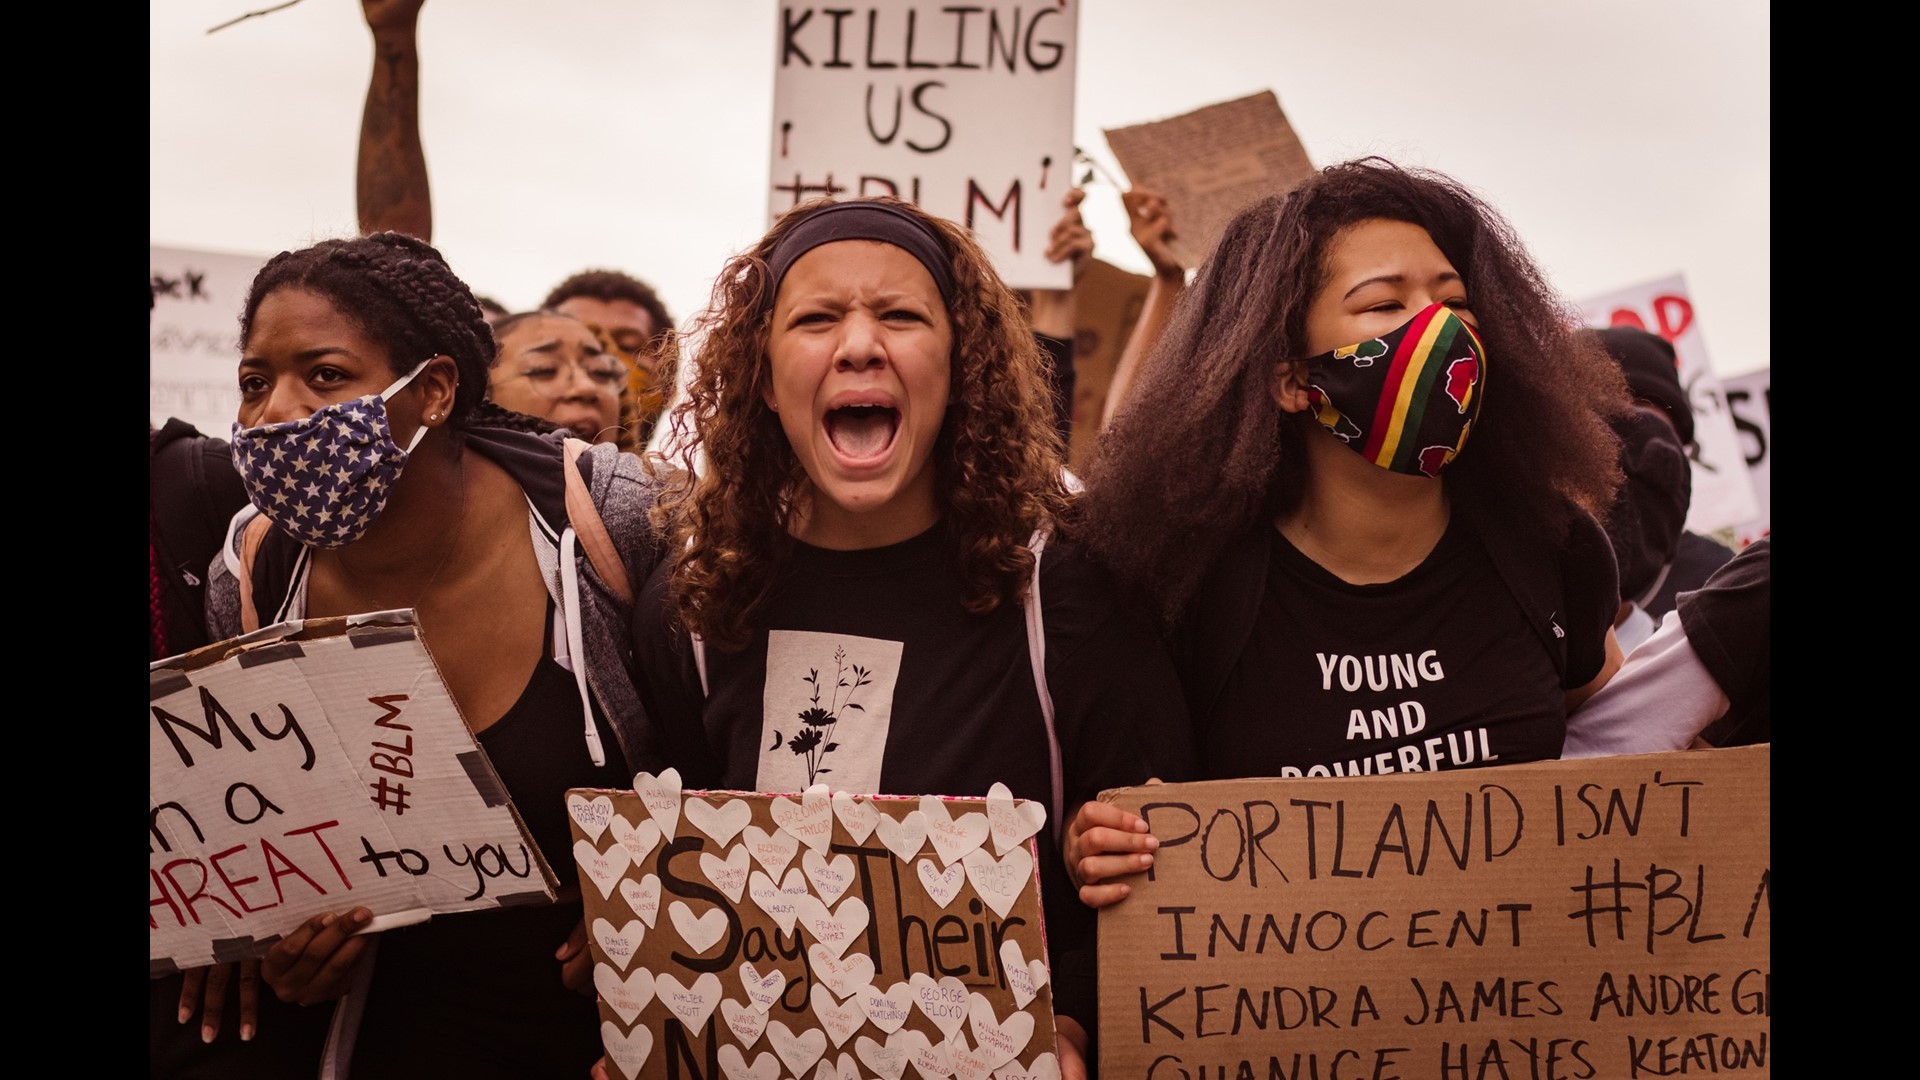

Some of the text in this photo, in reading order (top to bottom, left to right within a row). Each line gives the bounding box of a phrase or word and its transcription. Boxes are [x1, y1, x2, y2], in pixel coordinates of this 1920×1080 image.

[782, 7, 1065, 73] KILLING
[866, 81, 952, 153] US
[1316, 650, 1445, 691] YOUNG
[151, 685, 316, 771] My
[1346, 701, 1427, 740] AND
[368, 694, 414, 815] #BLM
[225, 782, 285, 825] a
[572, 803, 611, 815] TRAYVON
[777, 797, 830, 829] BREONNA
[576, 813, 609, 827] MARTIN
[795, 819, 832, 837] TAYLOR
[933, 819, 967, 838] GEORGE
[1140, 771, 1704, 888] PORTLAND ISN'T
[360, 836, 429, 878] to
[443, 843, 532, 902] you
[970, 864, 1017, 881] TAMIR
[979, 876, 1012, 897] RICE
[657, 836, 1026, 1013] Say Their
[814, 919, 846, 931] FRANK
[1157, 903, 1532, 960] INNOCENT
[604, 936, 629, 947] DANTE
[672, 992, 706, 1005] WALTER
[676, 1005, 701, 1017] SCOTT
[920, 986, 966, 1004] GEORGE
[925, 1001, 963, 1020] FLOYD
[1139, 983, 1380, 1044] KENDRA
[1404, 977, 1563, 1025] JAMES
[1590, 971, 1722, 1022] ANDRE
[978, 1031, 1016, 1054] CHAPMAN
[1440, 1038, 1596, 1080] HAYES
[1627, 1032, 1768, 1080] KEATON
